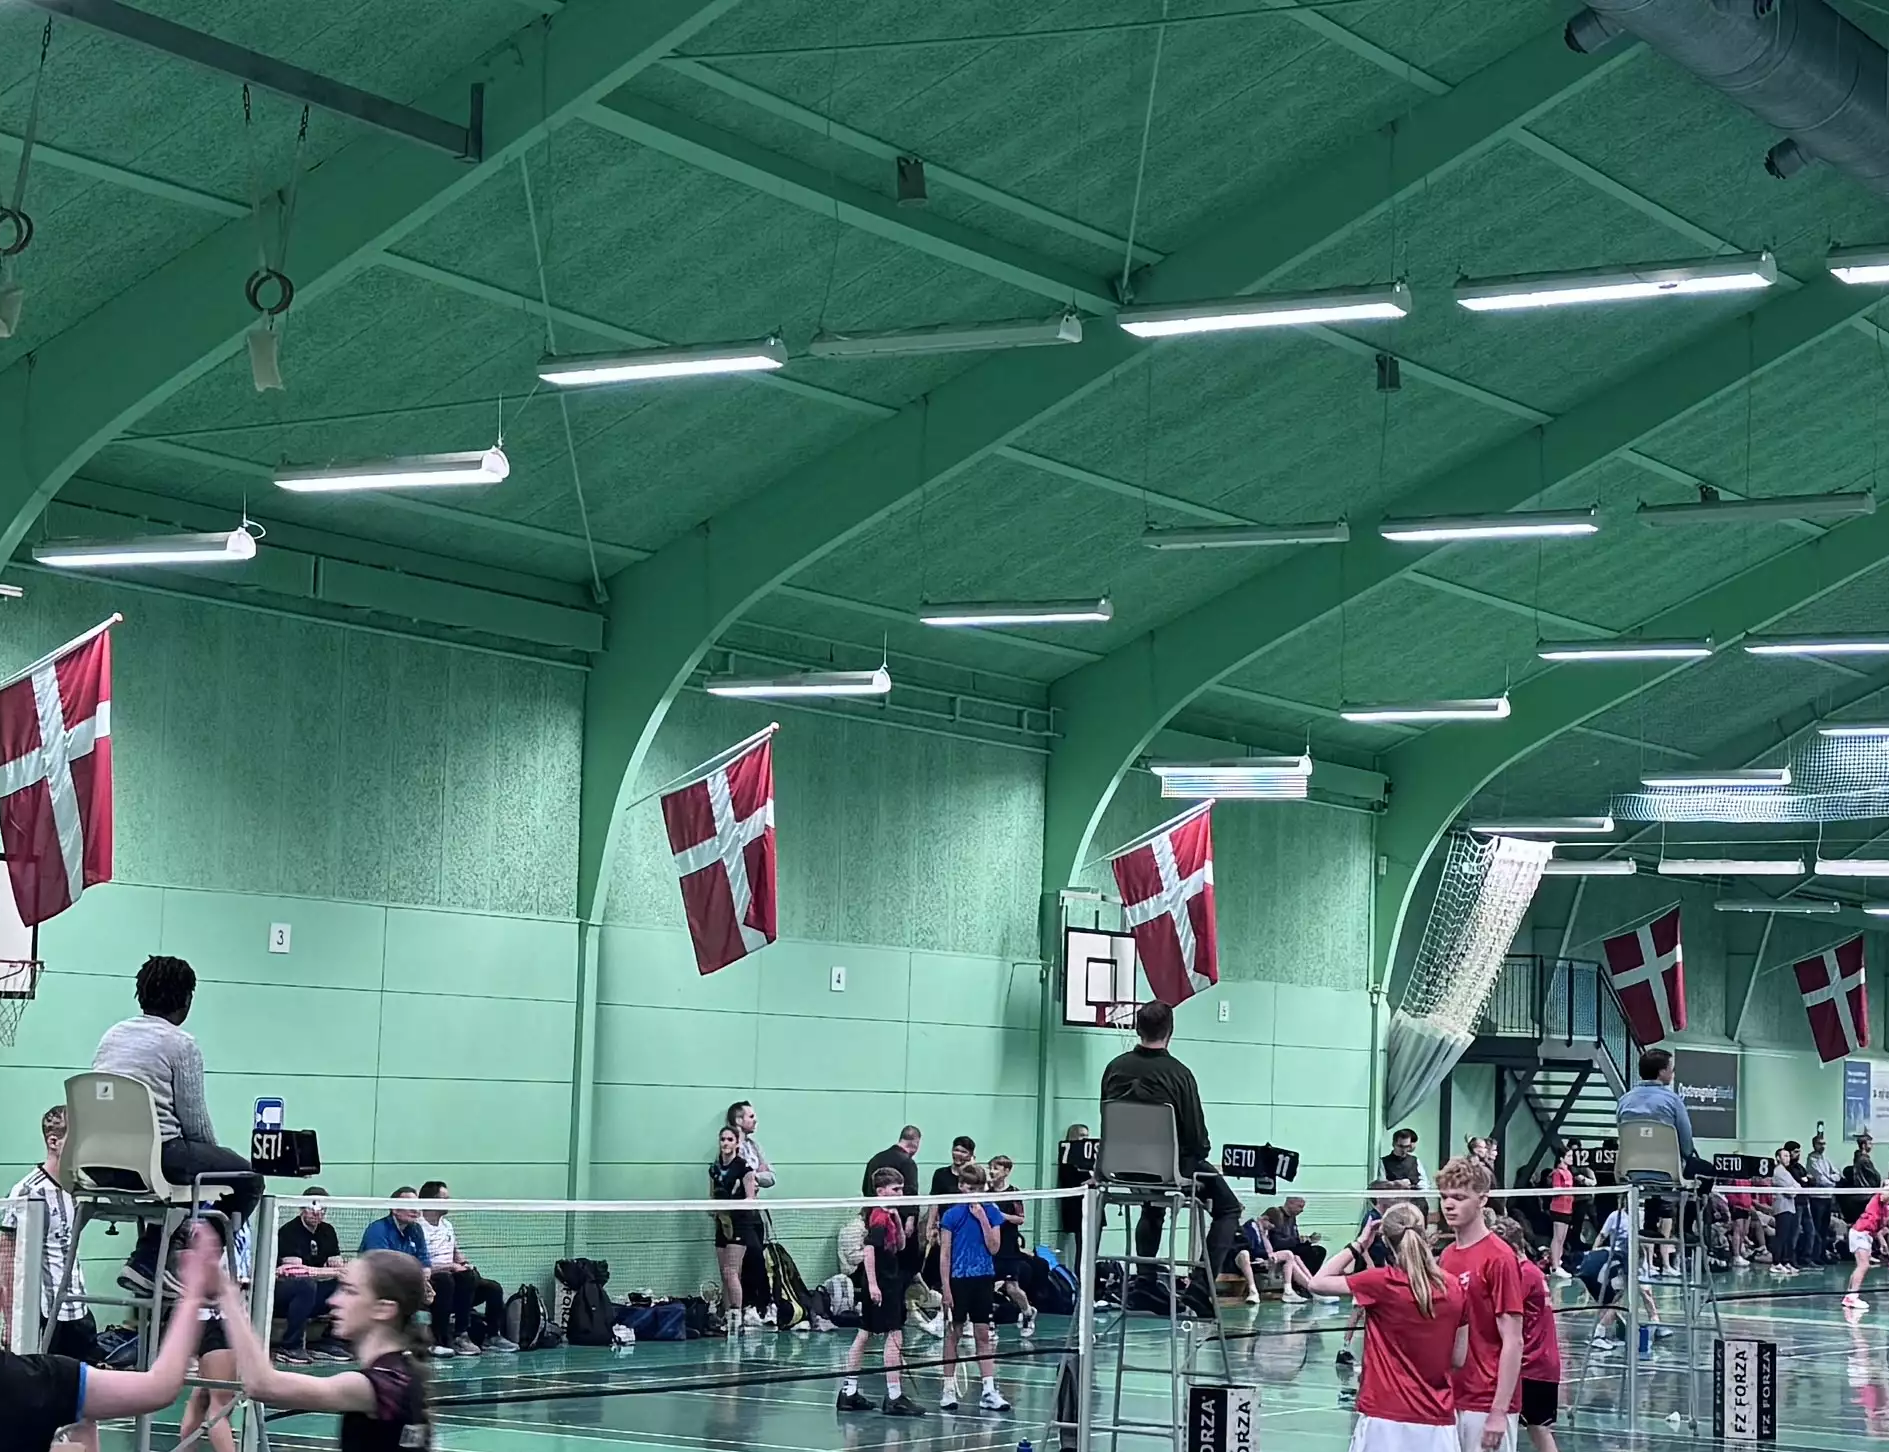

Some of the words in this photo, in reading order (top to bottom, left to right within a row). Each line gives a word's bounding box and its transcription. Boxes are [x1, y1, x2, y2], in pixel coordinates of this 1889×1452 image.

[276, 929, 284, 945] 3
[1061, 1142, 1071, 1165] 7
[1575, 1150, 1590, 1167] 12
[1276, 1154, 1290, 1177] 11
[1758, 1158, 1769, 1176] 8
[1734, 1349, 1748, 1407] FORZA
[1762, 1350, 1771, 1409] FORZA
[1734, 1413, 1747, 1433] FZ
